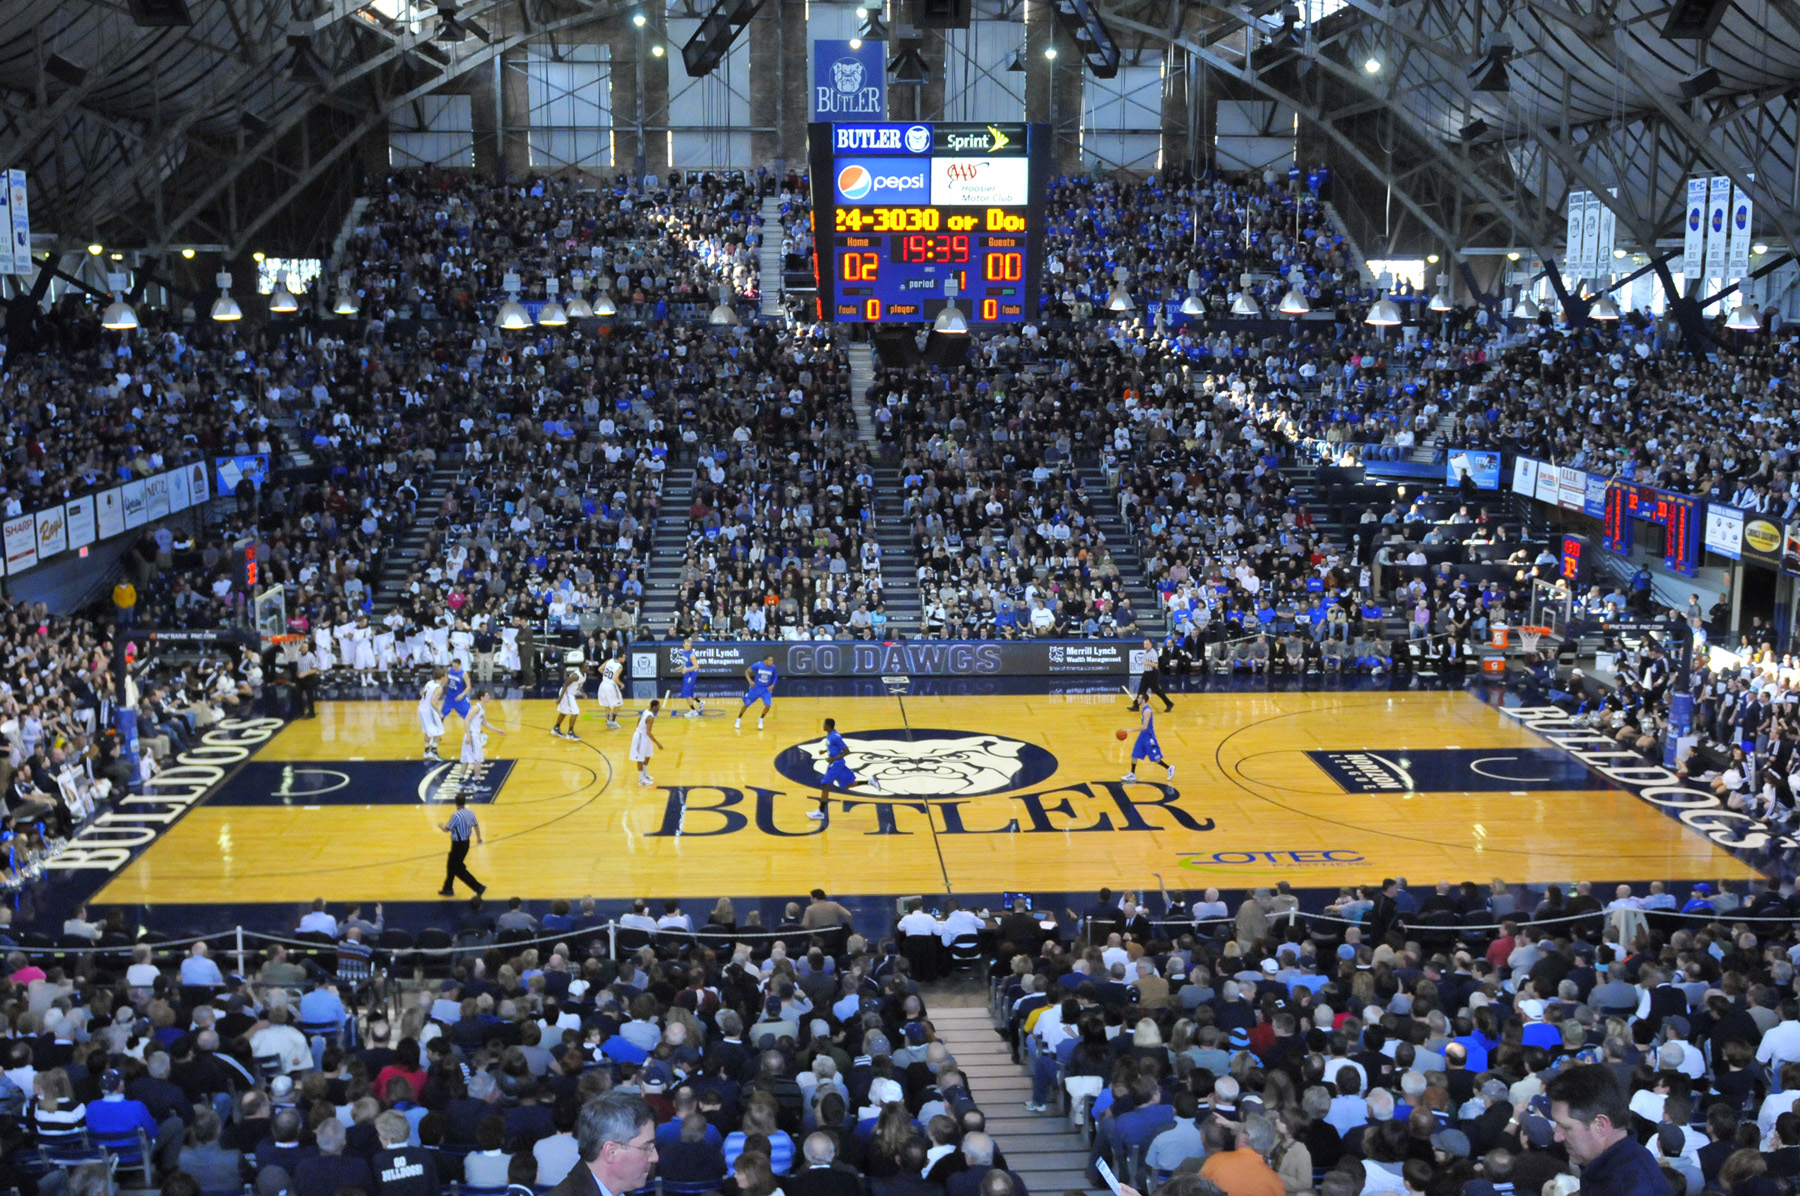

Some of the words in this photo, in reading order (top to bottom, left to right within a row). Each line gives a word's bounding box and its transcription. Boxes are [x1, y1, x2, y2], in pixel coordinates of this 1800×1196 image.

[816, 86, 880, 112] BUTLER
[837, 129, 901, 148] BUTLER
[947, 134, 989, 151] Sprint
[873, 173, 924, 191] pepsi
[962, 194, 989, 202] Motor
[992, 194, 1013, 202] Club
[947, 215, 978, 231] or
[847, 236, 869, 247] Home
[903, 235, 969, 263] 19:39
[988, 237, 1016, 247] Guests
[843, 252, 879, 281] 02
[986, 252, 1022, 281] 00
[909, 279, 934, 289] period
[960, 270, 967, 290] 1
[838, 305, 857, 315] fouls
[866, 298, 881, 320] 0
[890, 304, 915, 316] player
[983, 298, 998, 320] 0
[1002, 304, 1020, 315] fouls
[5, 518, 33, 538] SHARP
[692, 648, 715, 658] errill
[716, 648, 739, 658] Lynch
[788, 645, 842, 675] GO
[853, 644, 1001, 675] DAWGS
[1066, 646, 1092, 656] Merrill
[1093, 646, 1116, 656] Lynch
[1086, 656, 1121, 664] Management
[708, 658, 744, 666] Management
[603, 668, 614, 680] 20
[1328, 754, 1377, 790] LEAGUE
[1344, 754, 1402, 789] HORIZON
[1499, 705, 1798, 849] BULLDOGS
[44, 717, 285, 872] BULLDOGS
[644, 780, 1215, 837] BUTLER
